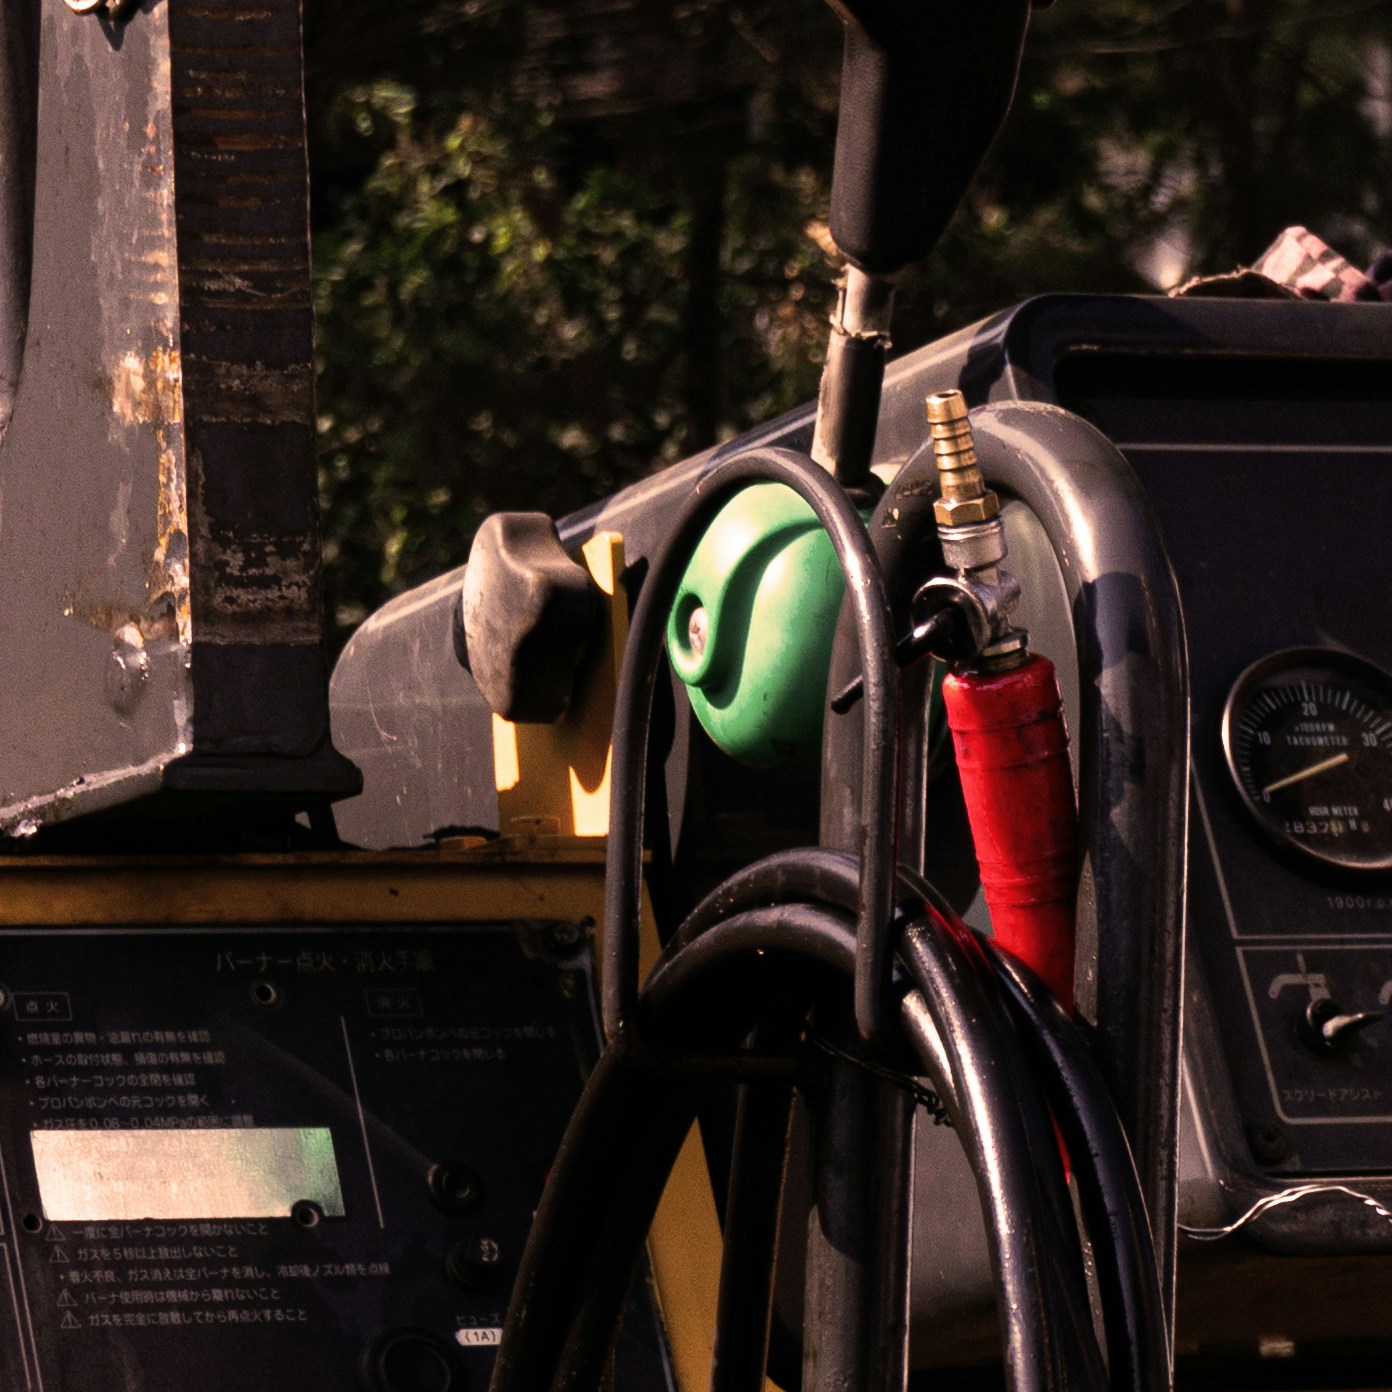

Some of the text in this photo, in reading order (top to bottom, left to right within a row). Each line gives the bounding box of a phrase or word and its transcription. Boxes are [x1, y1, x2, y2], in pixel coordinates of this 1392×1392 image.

[1302, 703, 1318, 716] 20
[1257, 731, 1272, 746] 10
[1286, 735, 1349, 747] TACHOMETER
[1361, 732, 1378, 747] 30
[1308, 805, 1359, 816] HOUR METER
